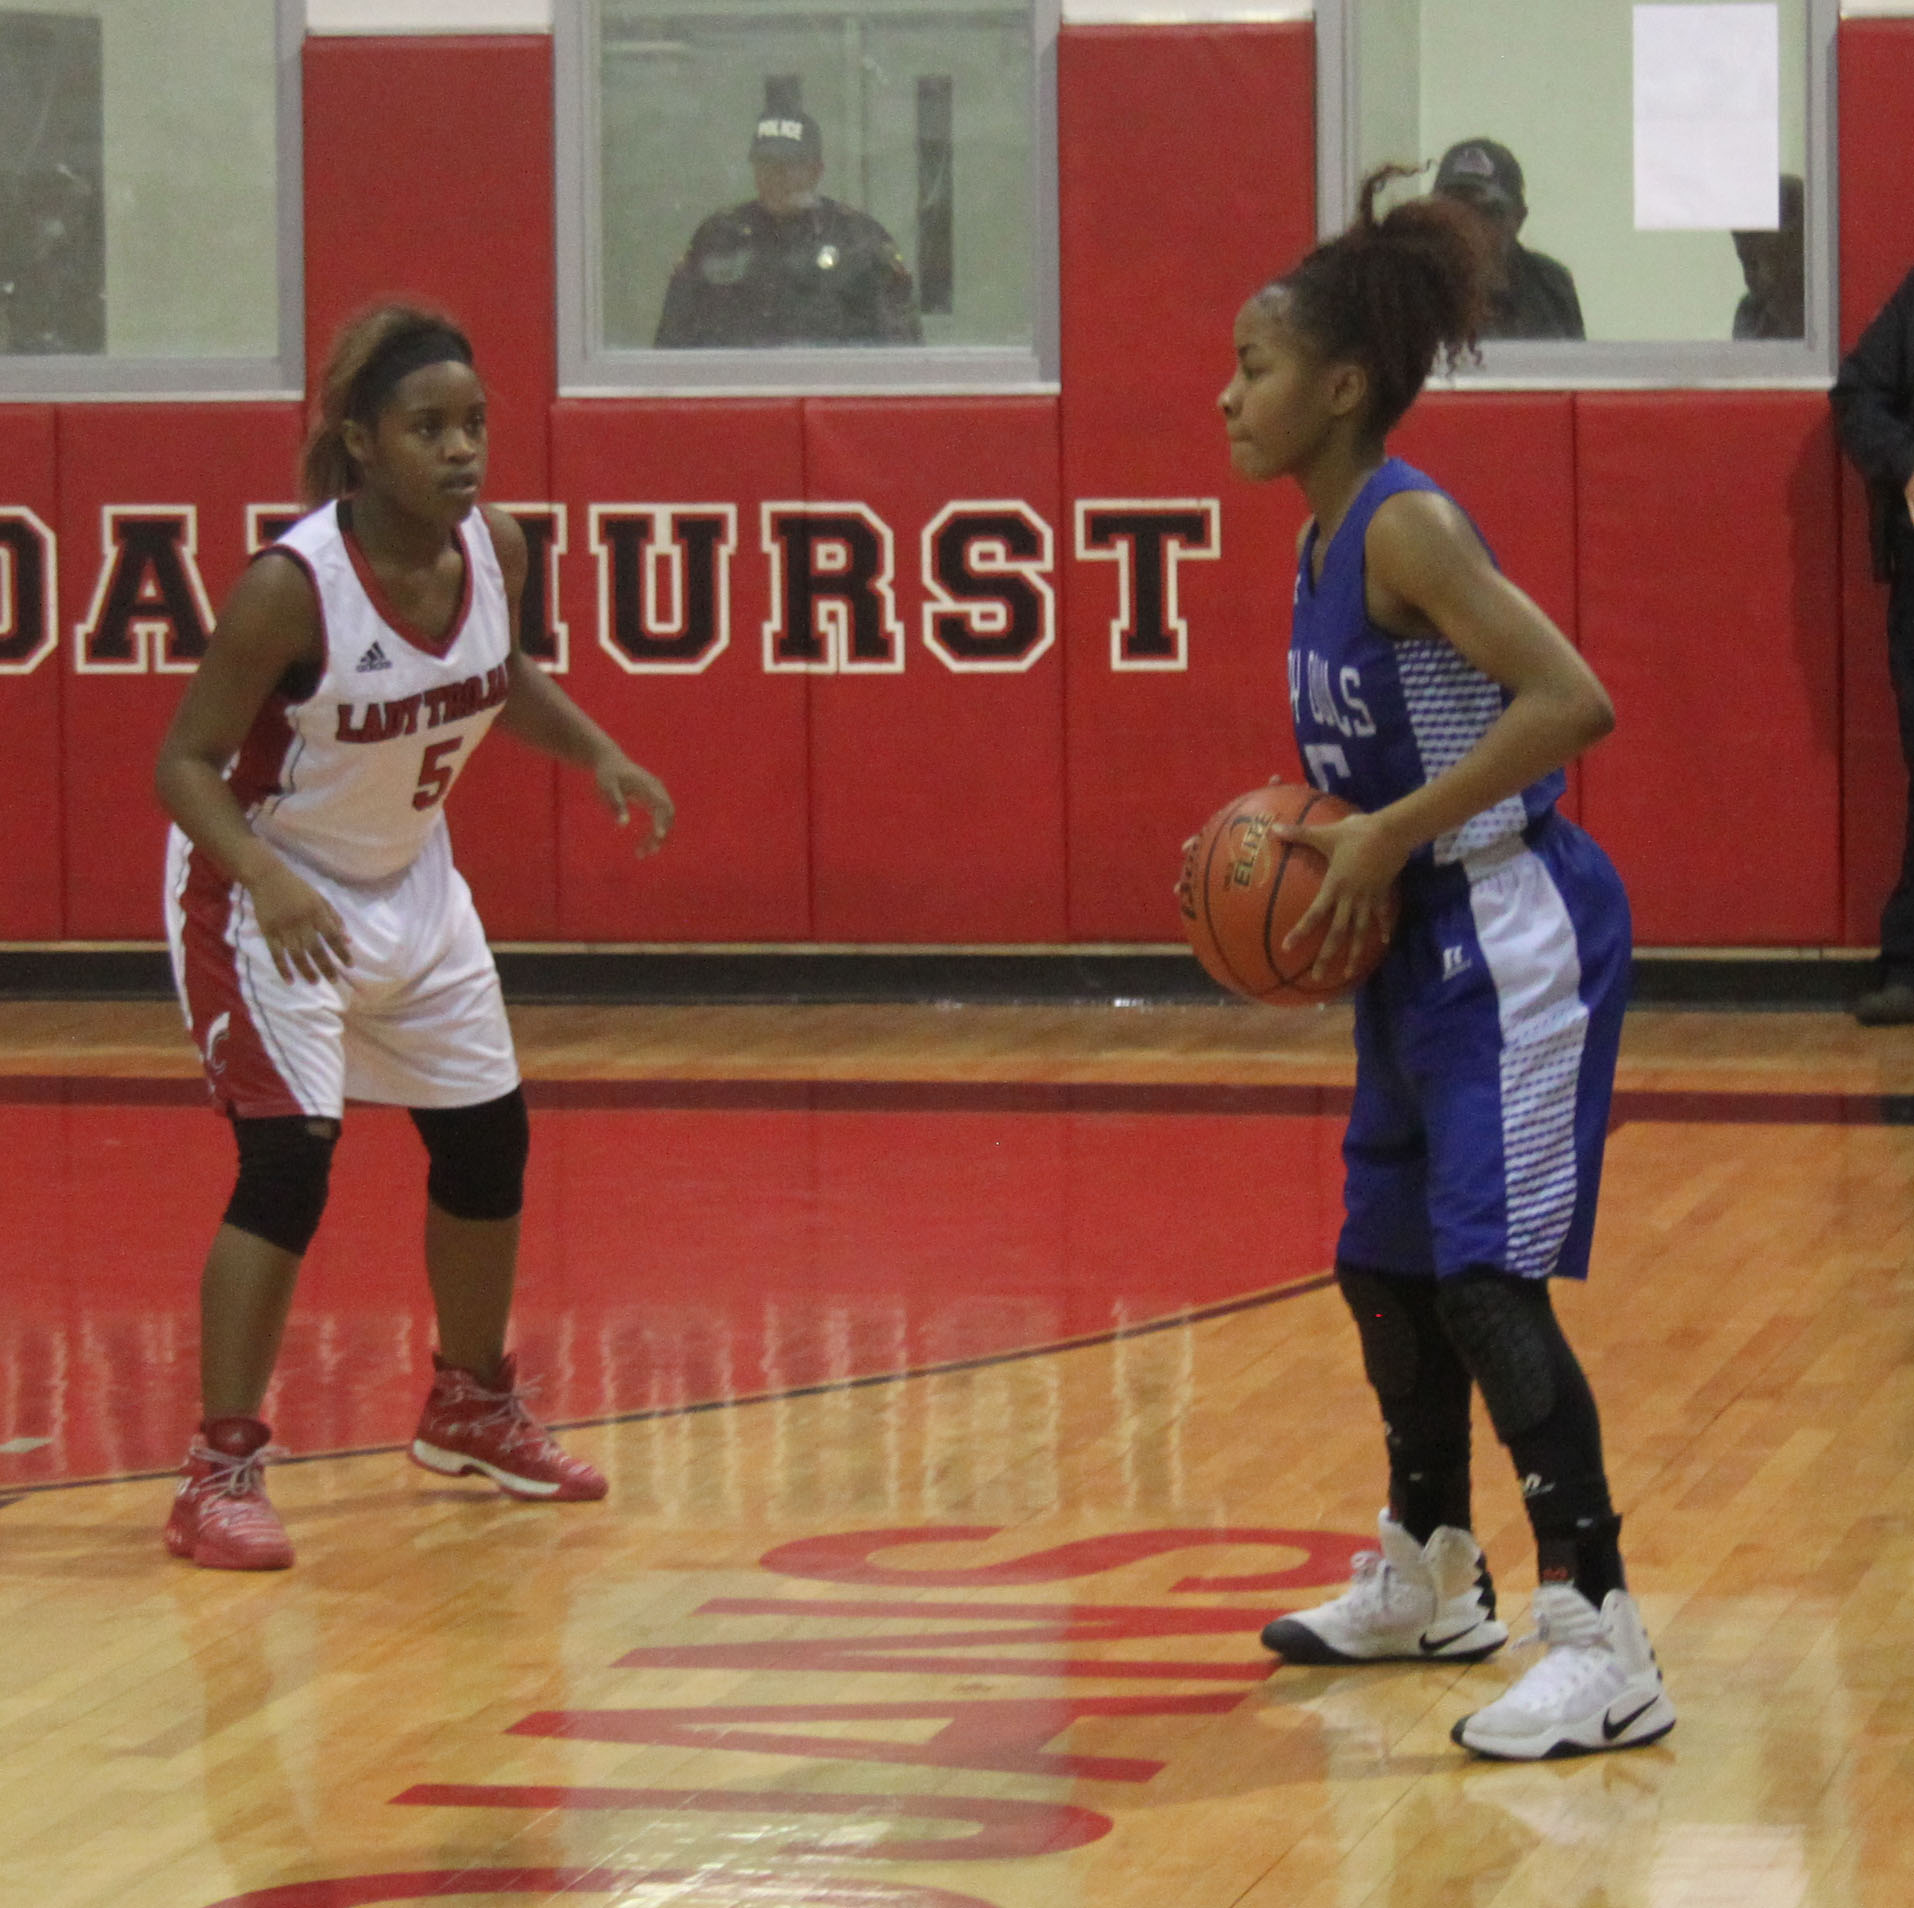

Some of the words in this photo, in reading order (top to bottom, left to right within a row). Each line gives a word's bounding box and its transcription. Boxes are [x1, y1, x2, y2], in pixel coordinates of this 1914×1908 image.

[0, 499, 1221, 675] AURST
[335, 690, 422, 743] LADY
[411, 735, 464, 812] 5
[1233, 813, 1275, 887] ELITE
[195, 1526, 1385, 1907] JANS
